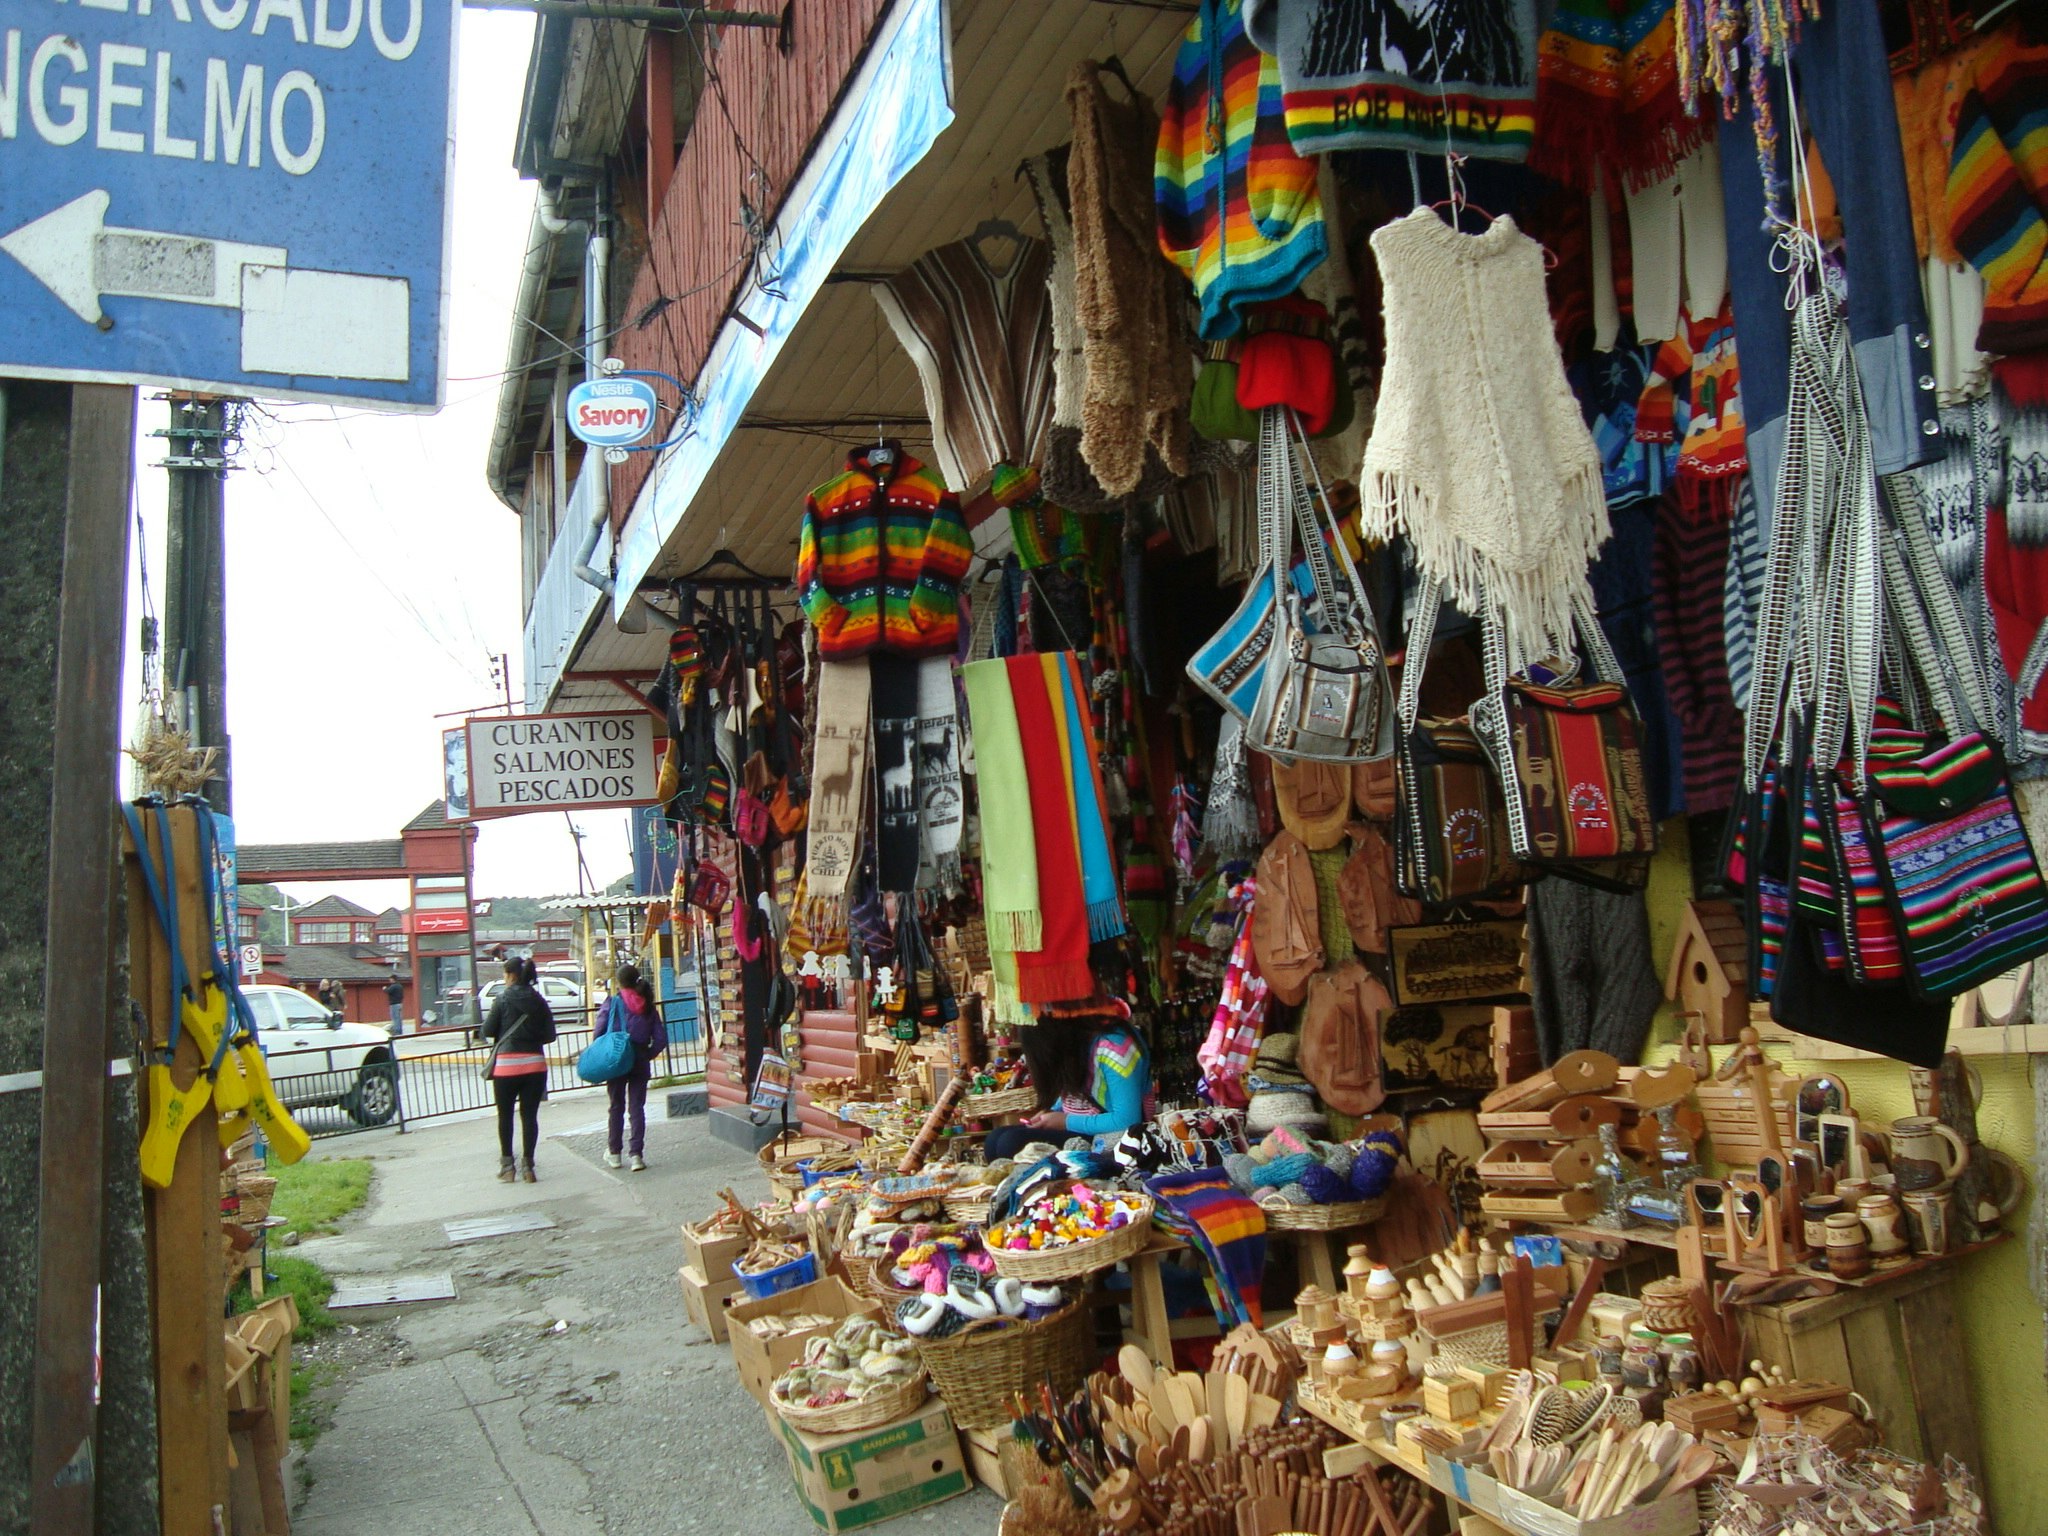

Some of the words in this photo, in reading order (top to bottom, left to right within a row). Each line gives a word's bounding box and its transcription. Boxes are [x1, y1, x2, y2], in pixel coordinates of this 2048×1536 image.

[1333, 87, 1391, 132] BOB
[1403, 96, 1503, 144] MARLEY
[579, 404, 648, 428] Savory
[492, 719, 635, 746] CURANTOS
[494, 748, 635, 774] SALMONES
[499, 775, 634, 803] PESCADOS
[811, 834, 834, 861] PUERTO
[811, 867, 846, 877] CHILE
